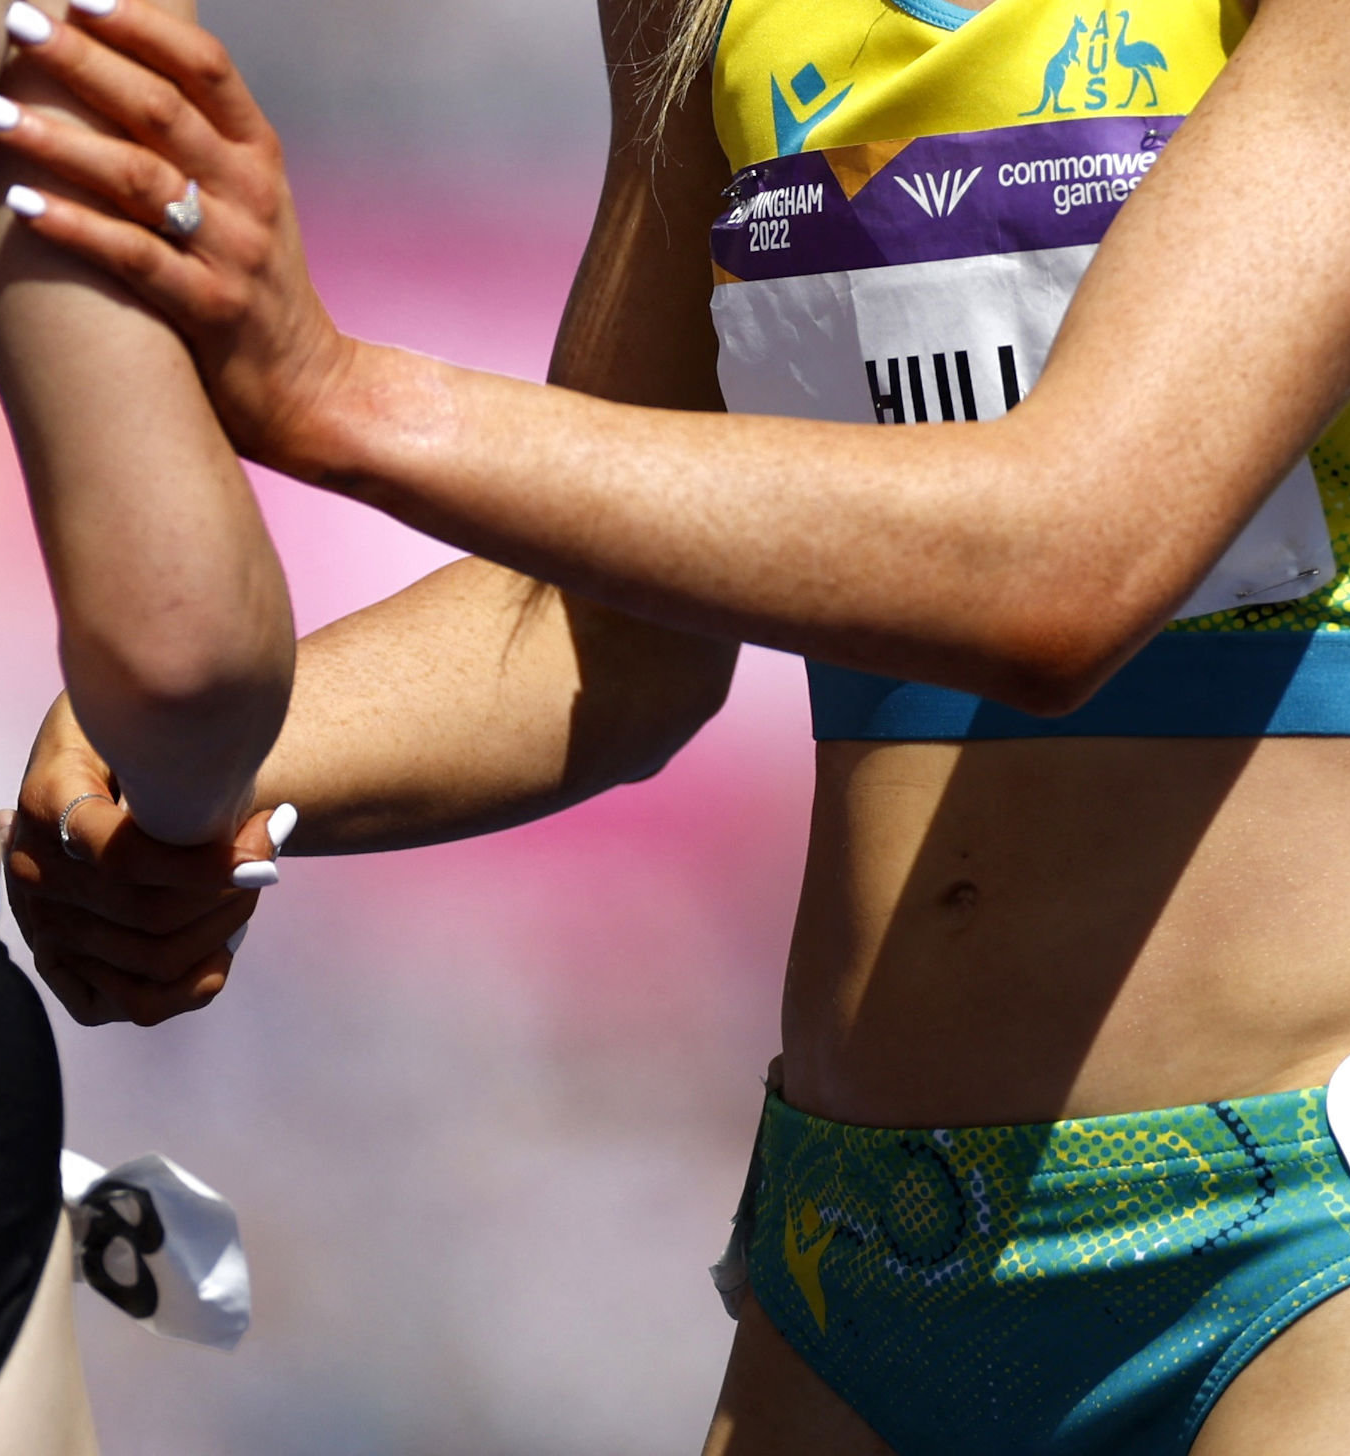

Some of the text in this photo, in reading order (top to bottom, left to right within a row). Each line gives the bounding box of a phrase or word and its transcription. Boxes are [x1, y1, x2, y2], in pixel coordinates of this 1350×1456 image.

[998, 151, 1157, 187] commonwe
[749, 218, 791, 252] 2022
[81, 1180, 165, 1319] 8
